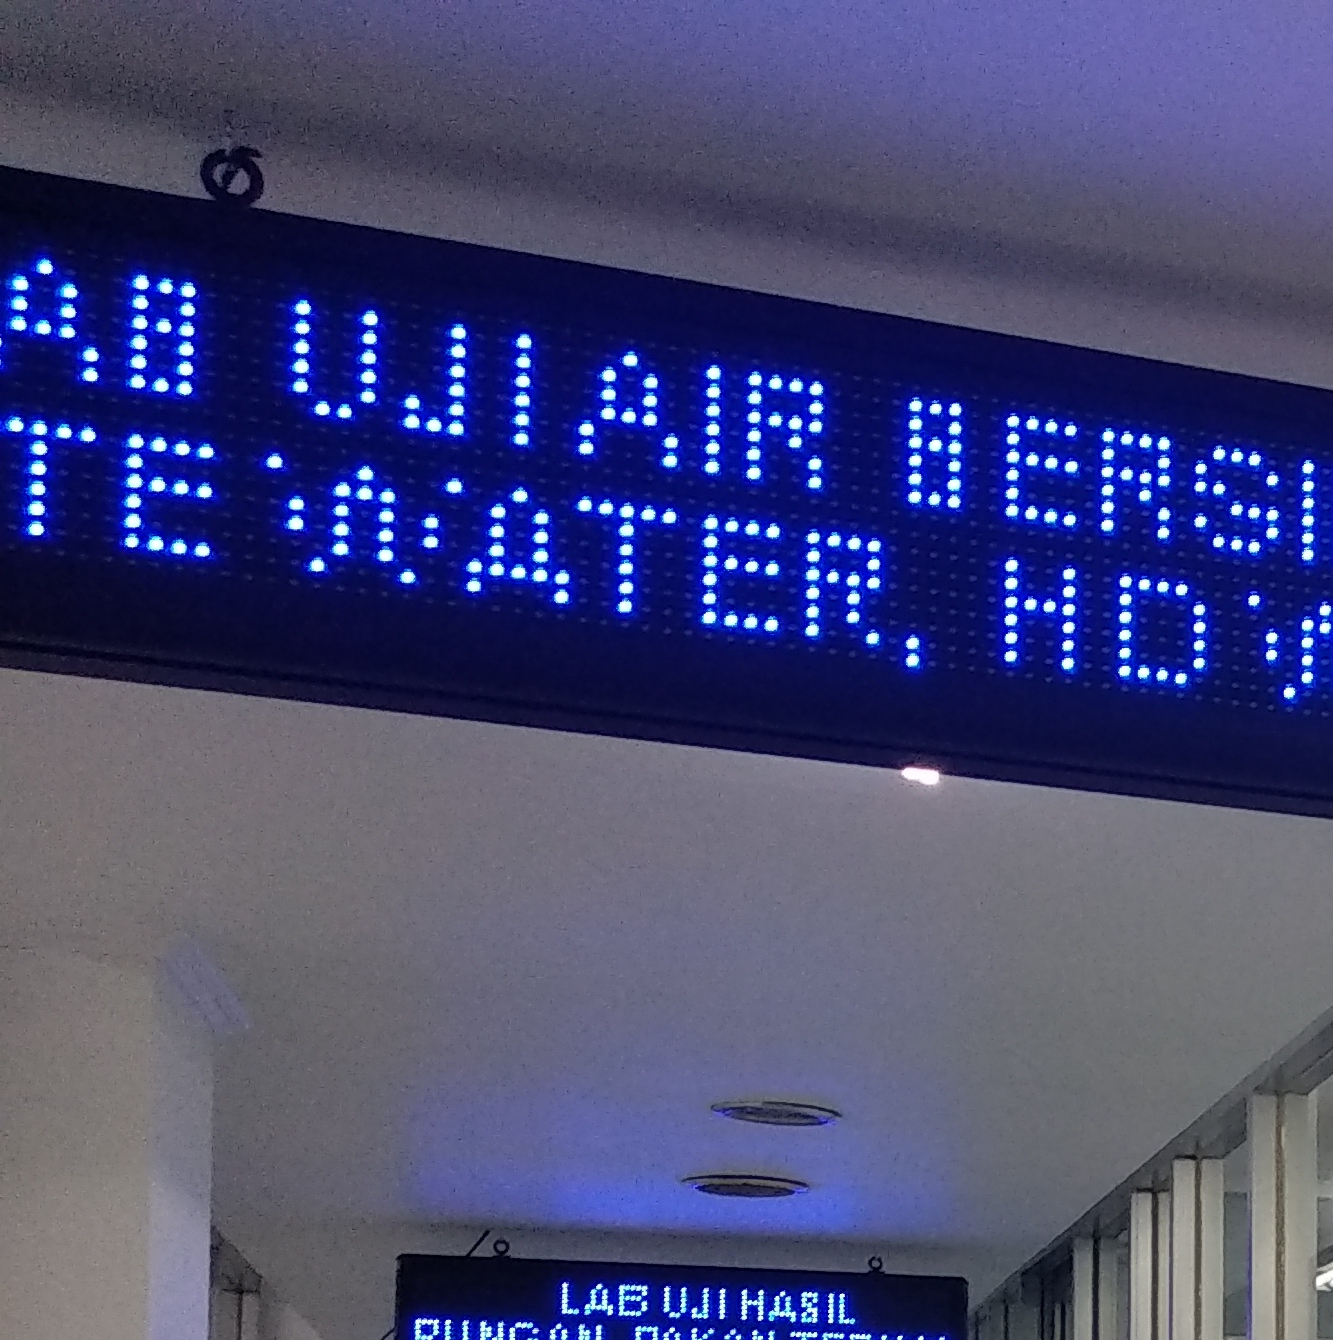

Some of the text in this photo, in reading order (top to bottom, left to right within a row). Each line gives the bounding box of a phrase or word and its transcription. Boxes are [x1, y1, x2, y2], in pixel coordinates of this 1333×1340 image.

[560, 1281, 856, 1326] LAB UJI HASIL
